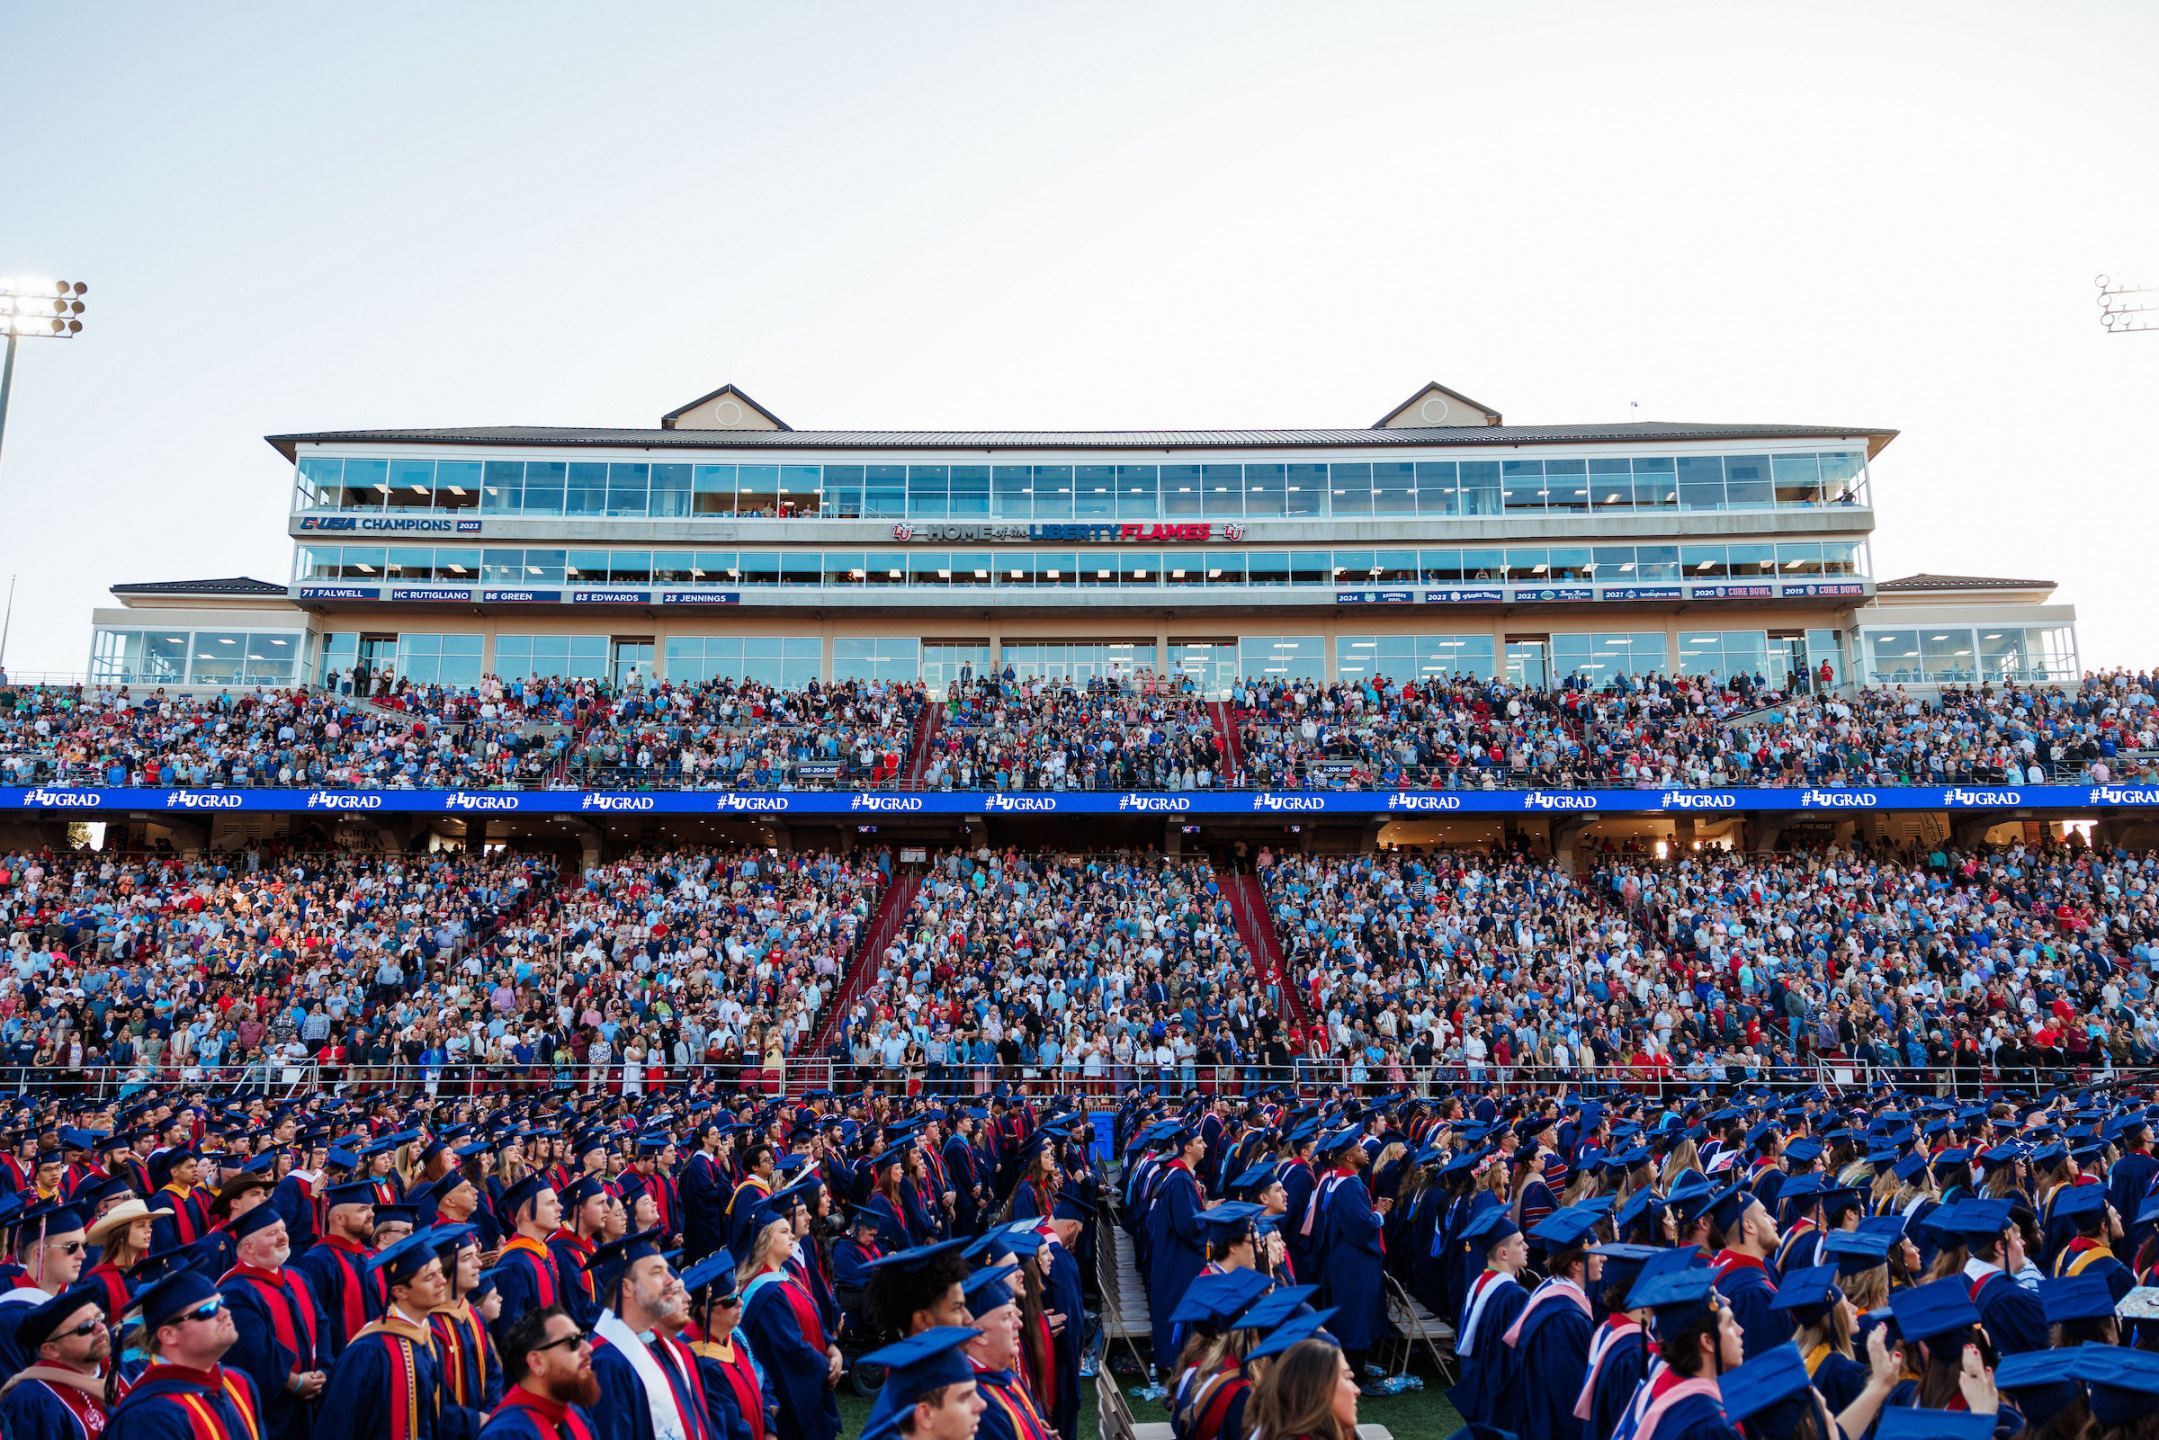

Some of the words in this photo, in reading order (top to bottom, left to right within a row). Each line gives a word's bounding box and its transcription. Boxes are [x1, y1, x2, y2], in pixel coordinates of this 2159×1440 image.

[362, 518, 451, 531] CHAMPIONS
[927, 524, 992, 540] HOME
[995, 527, 1006, 540] of
[1009, 526, 1027, 538] the
[1749, 587, 1771, 595] BOWL
[1819, 586, 1839, 594] CURE
[1840, 585, 1862, 593] BOWL
[318, 590, 363, 598] FALWELL
[410, 591, 469, 600] RUTIGLIANO
[485, 593, 498, 601] 86
[501, 593, 533, 601] GREEN
[591, 594, 639, 602] EDWARDS
[680, 595, 727, 603] JENNINGS
[340, 828, 378, 837] Carter
